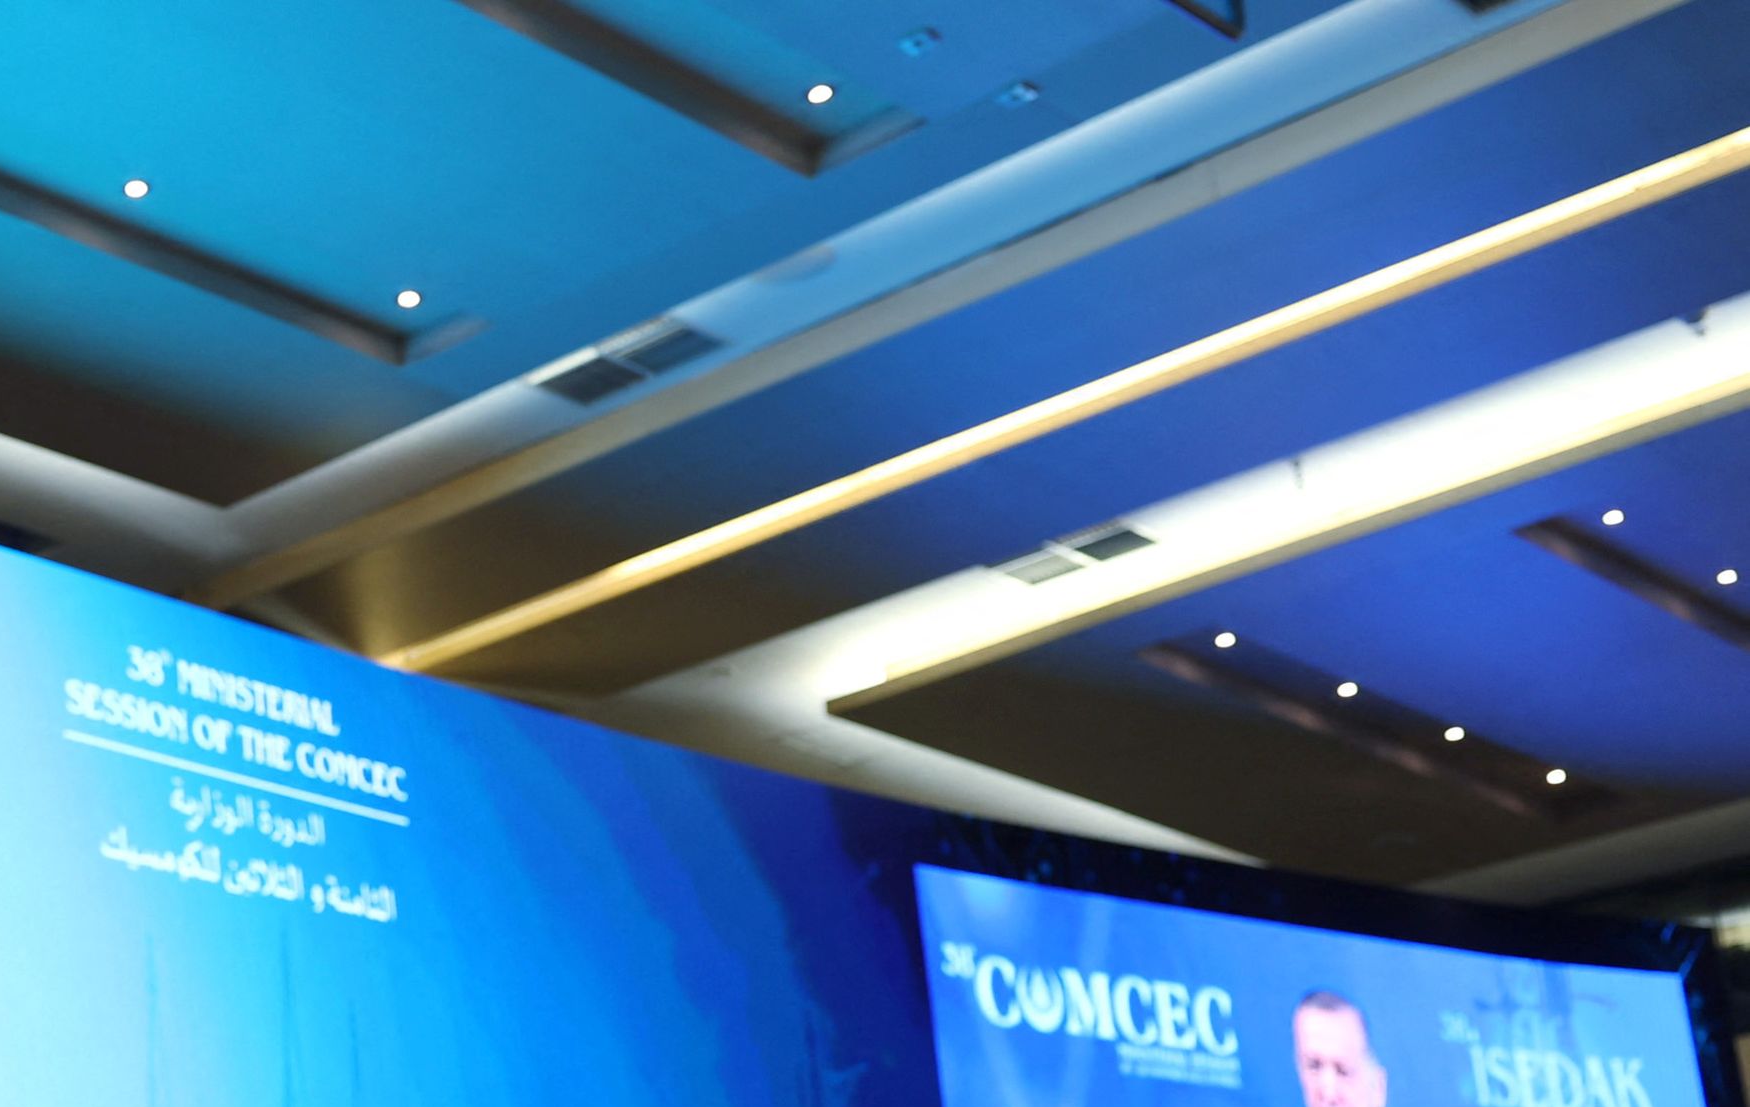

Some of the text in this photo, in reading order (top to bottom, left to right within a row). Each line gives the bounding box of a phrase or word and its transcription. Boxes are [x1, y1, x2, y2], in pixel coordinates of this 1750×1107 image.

[64, 678, 409, 803] SESSION OF THE COMCEC
[176, 658, 341, 737] MINISTERIAL
[974, 955, 1239, 1057] COMCEC
